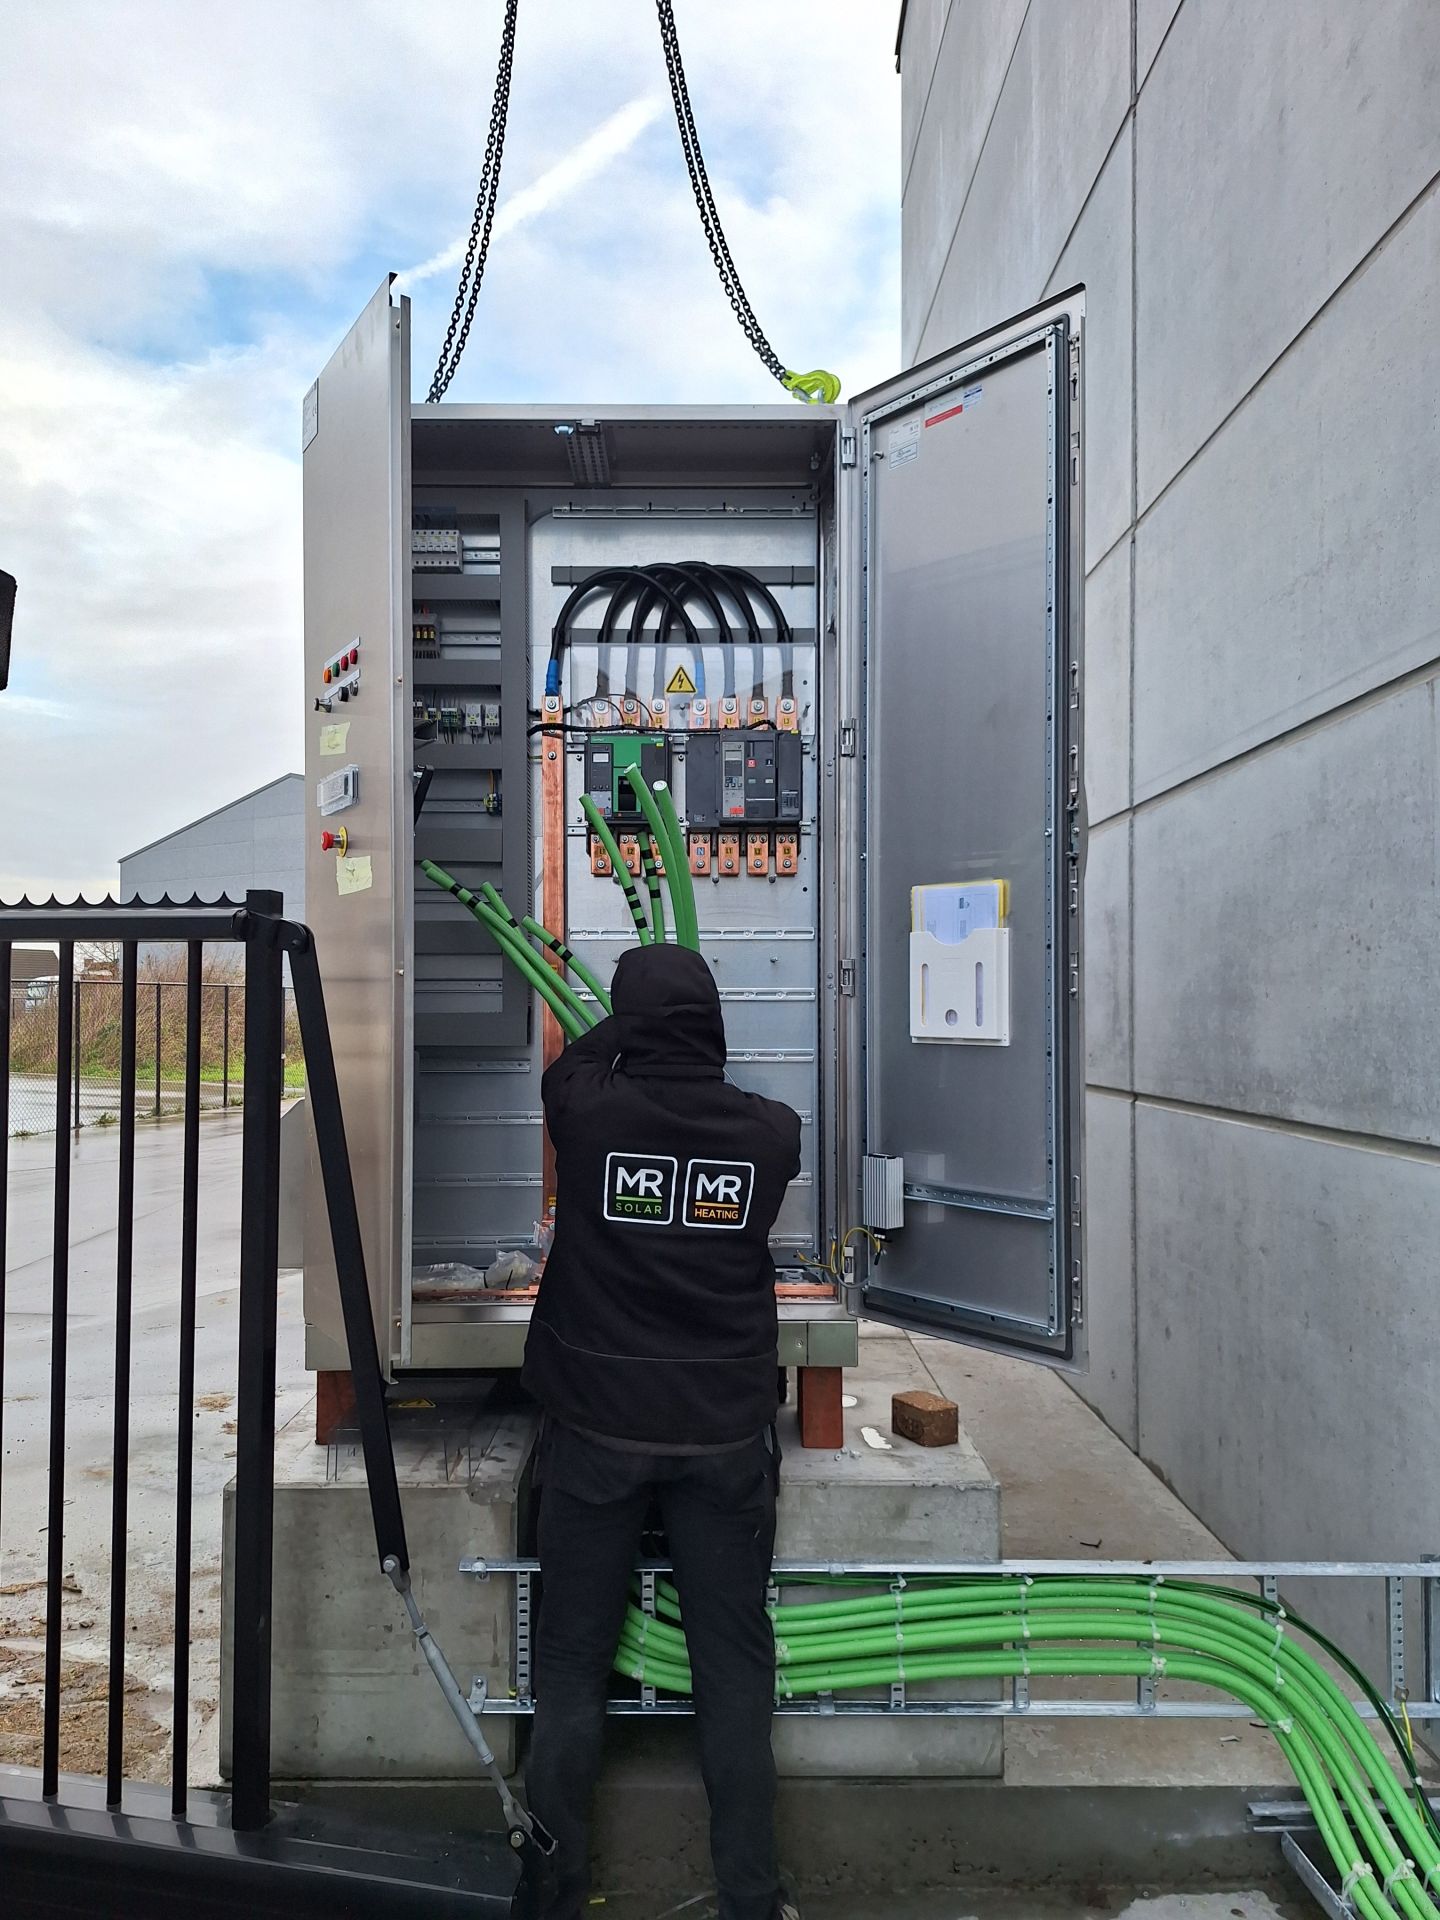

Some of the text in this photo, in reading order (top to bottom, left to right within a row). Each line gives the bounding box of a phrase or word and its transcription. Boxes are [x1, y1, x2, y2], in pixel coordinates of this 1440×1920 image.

[616, 1166, 664, 1197] MR
[695, 1173, 742, 1203] MR
[615, 1202, 662, 1215] SOLAR
[694, 1208, 739, 1220] HEATING
